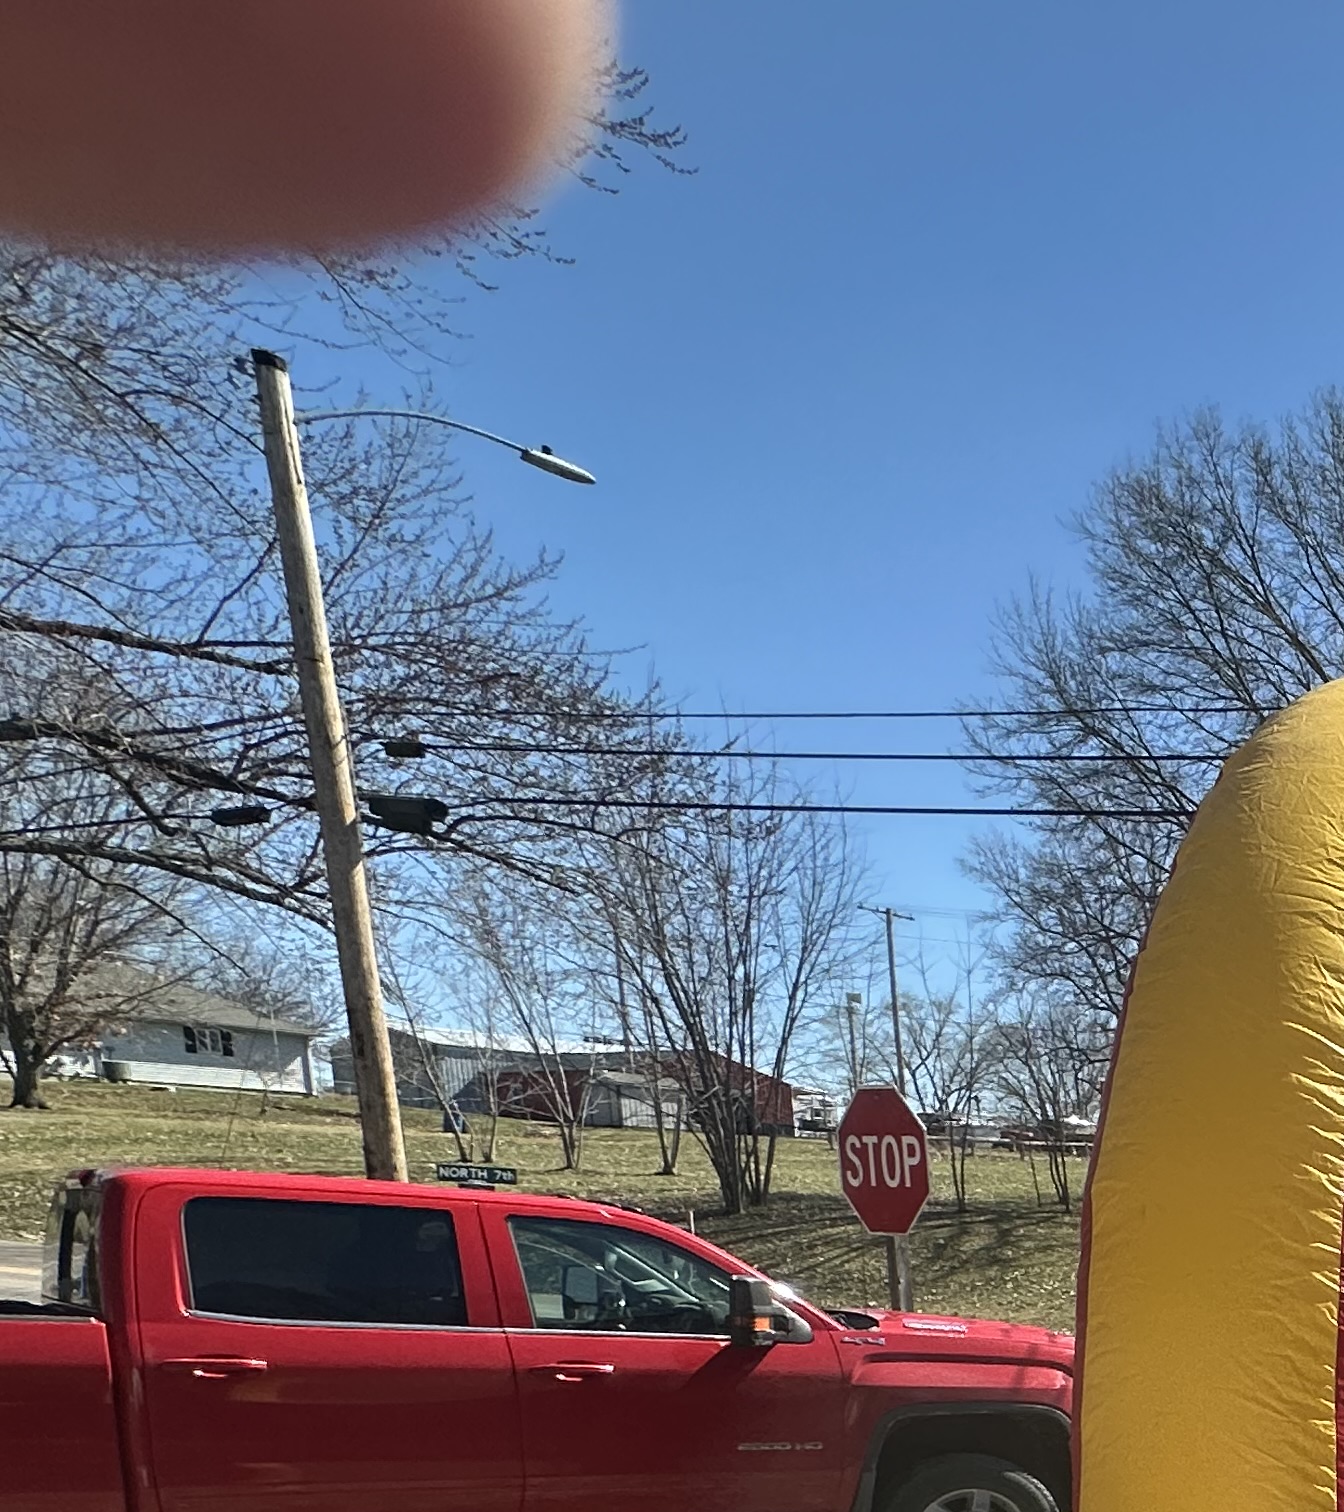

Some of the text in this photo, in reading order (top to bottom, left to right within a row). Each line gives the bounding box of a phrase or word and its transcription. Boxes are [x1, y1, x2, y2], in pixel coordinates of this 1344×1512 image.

[439, 1166, 515, 1181] NORTH 7th
[845, 1134, 921, 1188] STOP
